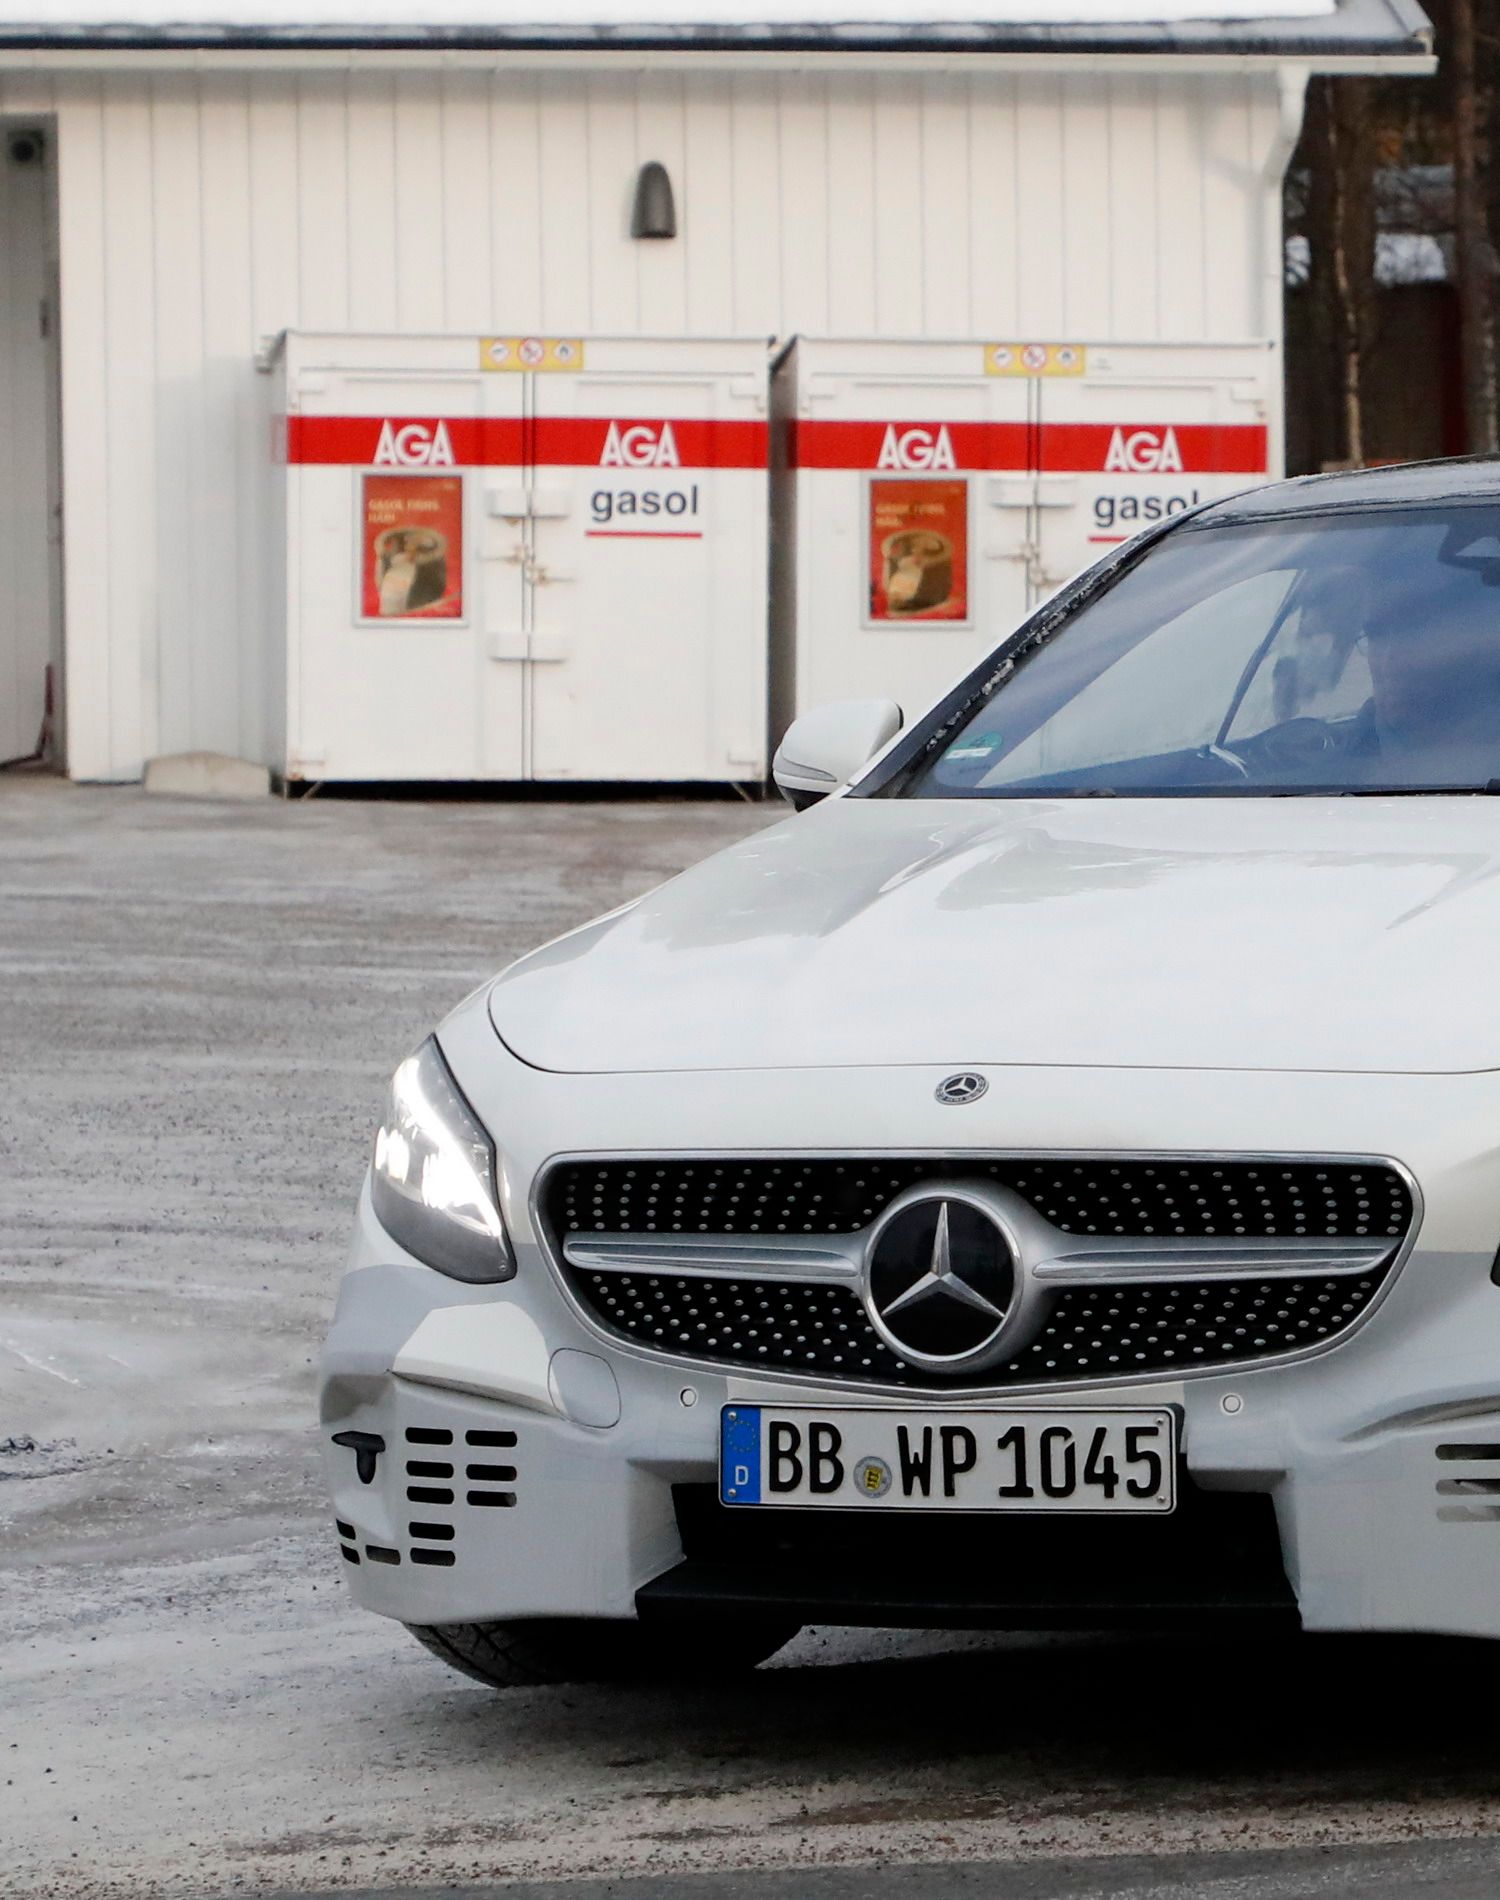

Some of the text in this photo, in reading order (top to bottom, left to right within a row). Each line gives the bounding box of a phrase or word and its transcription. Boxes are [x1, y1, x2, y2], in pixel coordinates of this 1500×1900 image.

[372, 419, 455, 465] AGA
[600, 420, 680, 467] AGA
[876, 423, 956, 469] AGA
[1104, 426, 1183, 472] AGA
[590, 485, 698, 522] gasol
[735, 1465, 748, 1485] D
[768, 1420, 1162, 1498] BB WP 1045
